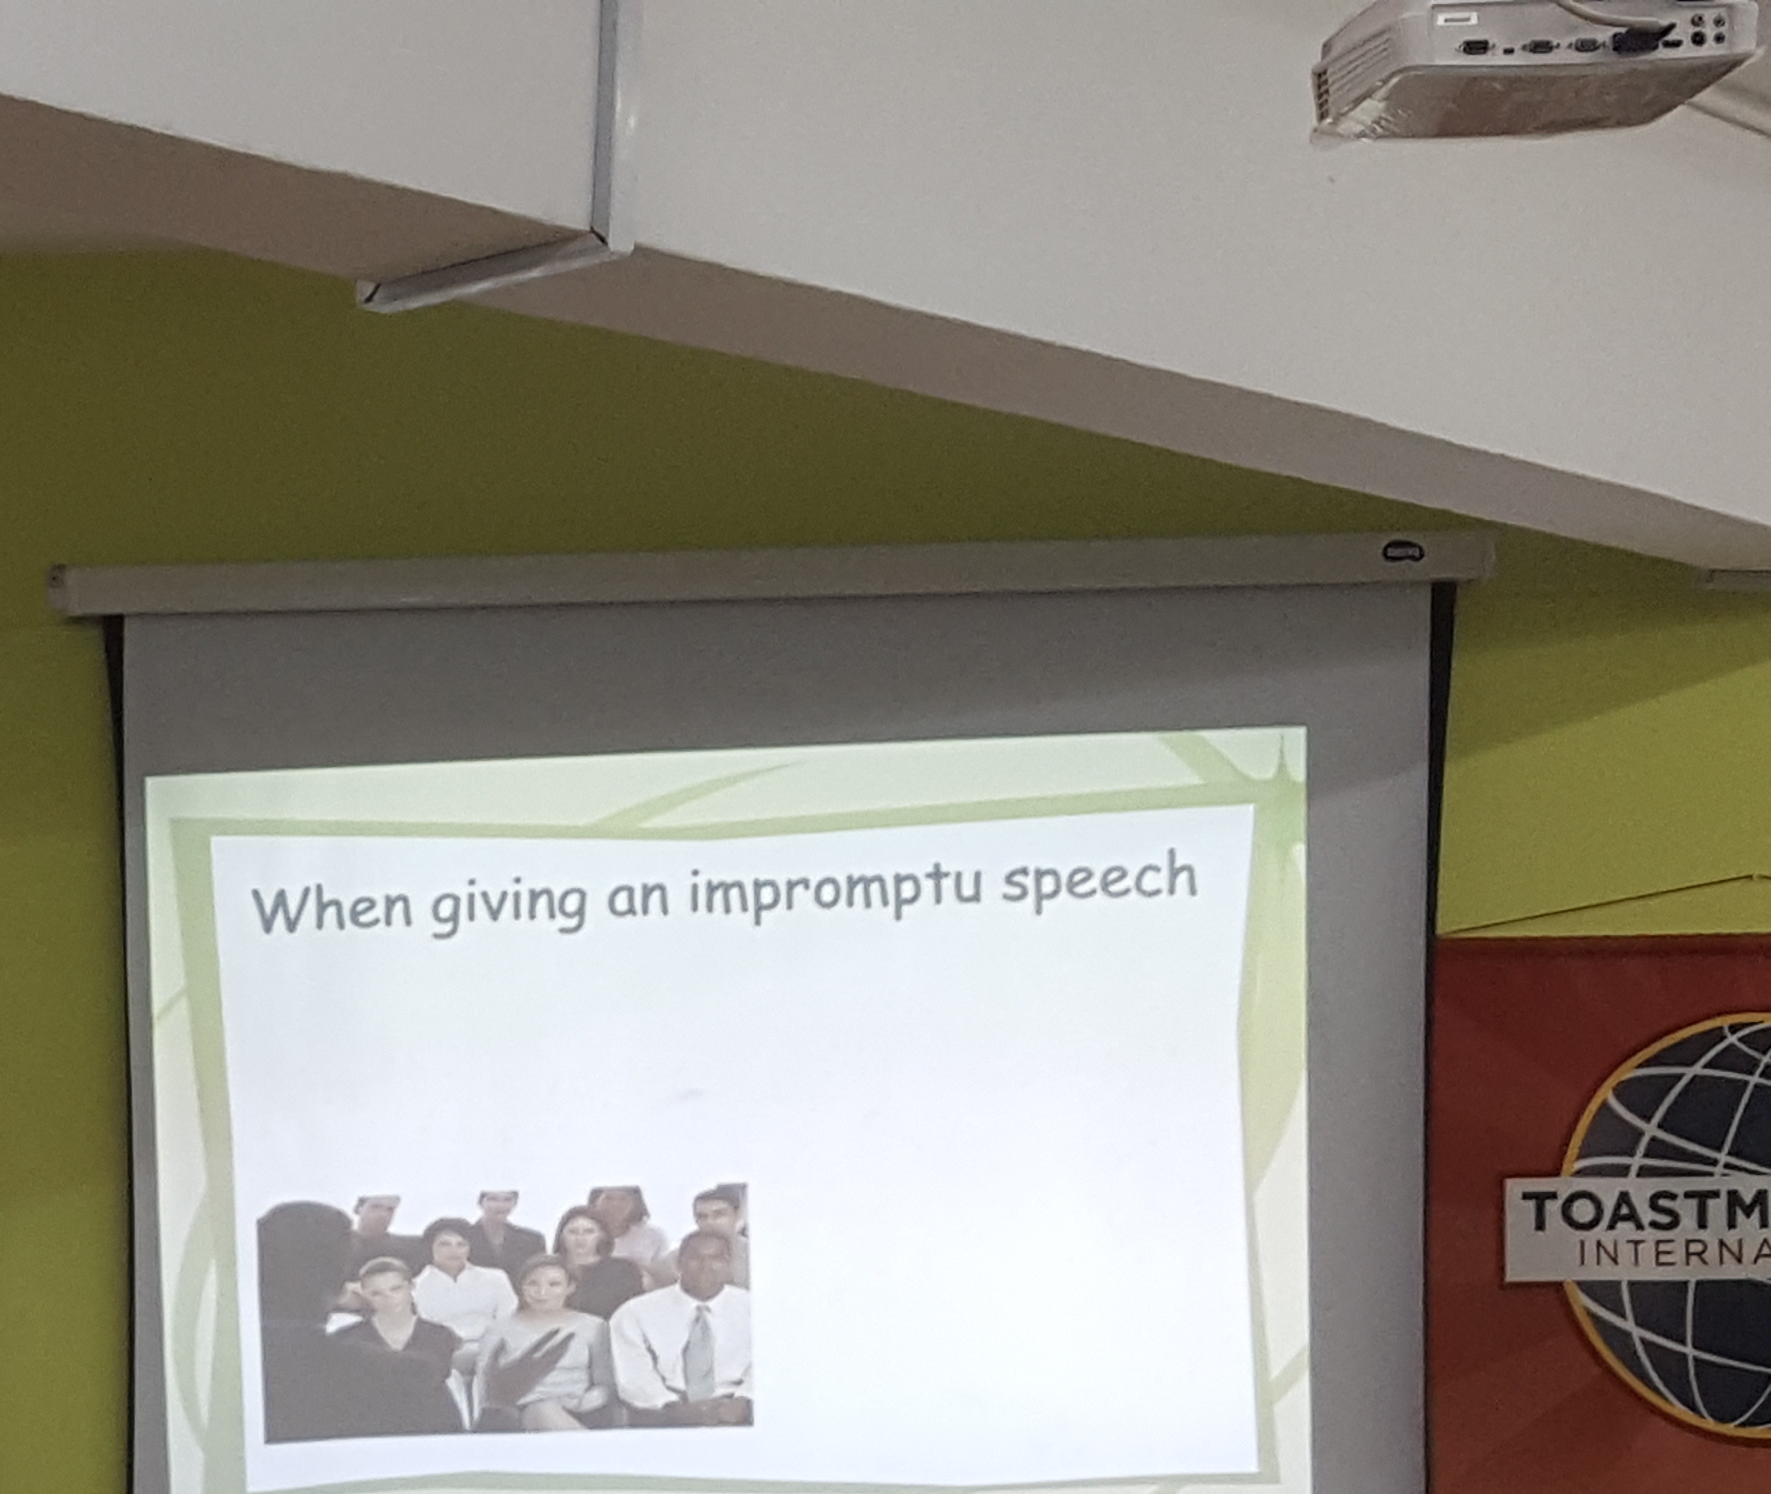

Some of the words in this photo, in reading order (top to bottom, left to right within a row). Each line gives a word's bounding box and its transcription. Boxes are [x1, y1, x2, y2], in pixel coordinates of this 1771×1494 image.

[250, 883, 412, 935] When
[430, 876, 588, 940] giving
[606, 881, 670, 917] an
[689, 862, 983, 926] impromptu
[1001, 847, 1198, 916] speech
[1520, 1188, 1771, 1231] TOASTM
[1578, 1237, 1771, 1267] INTERNA
